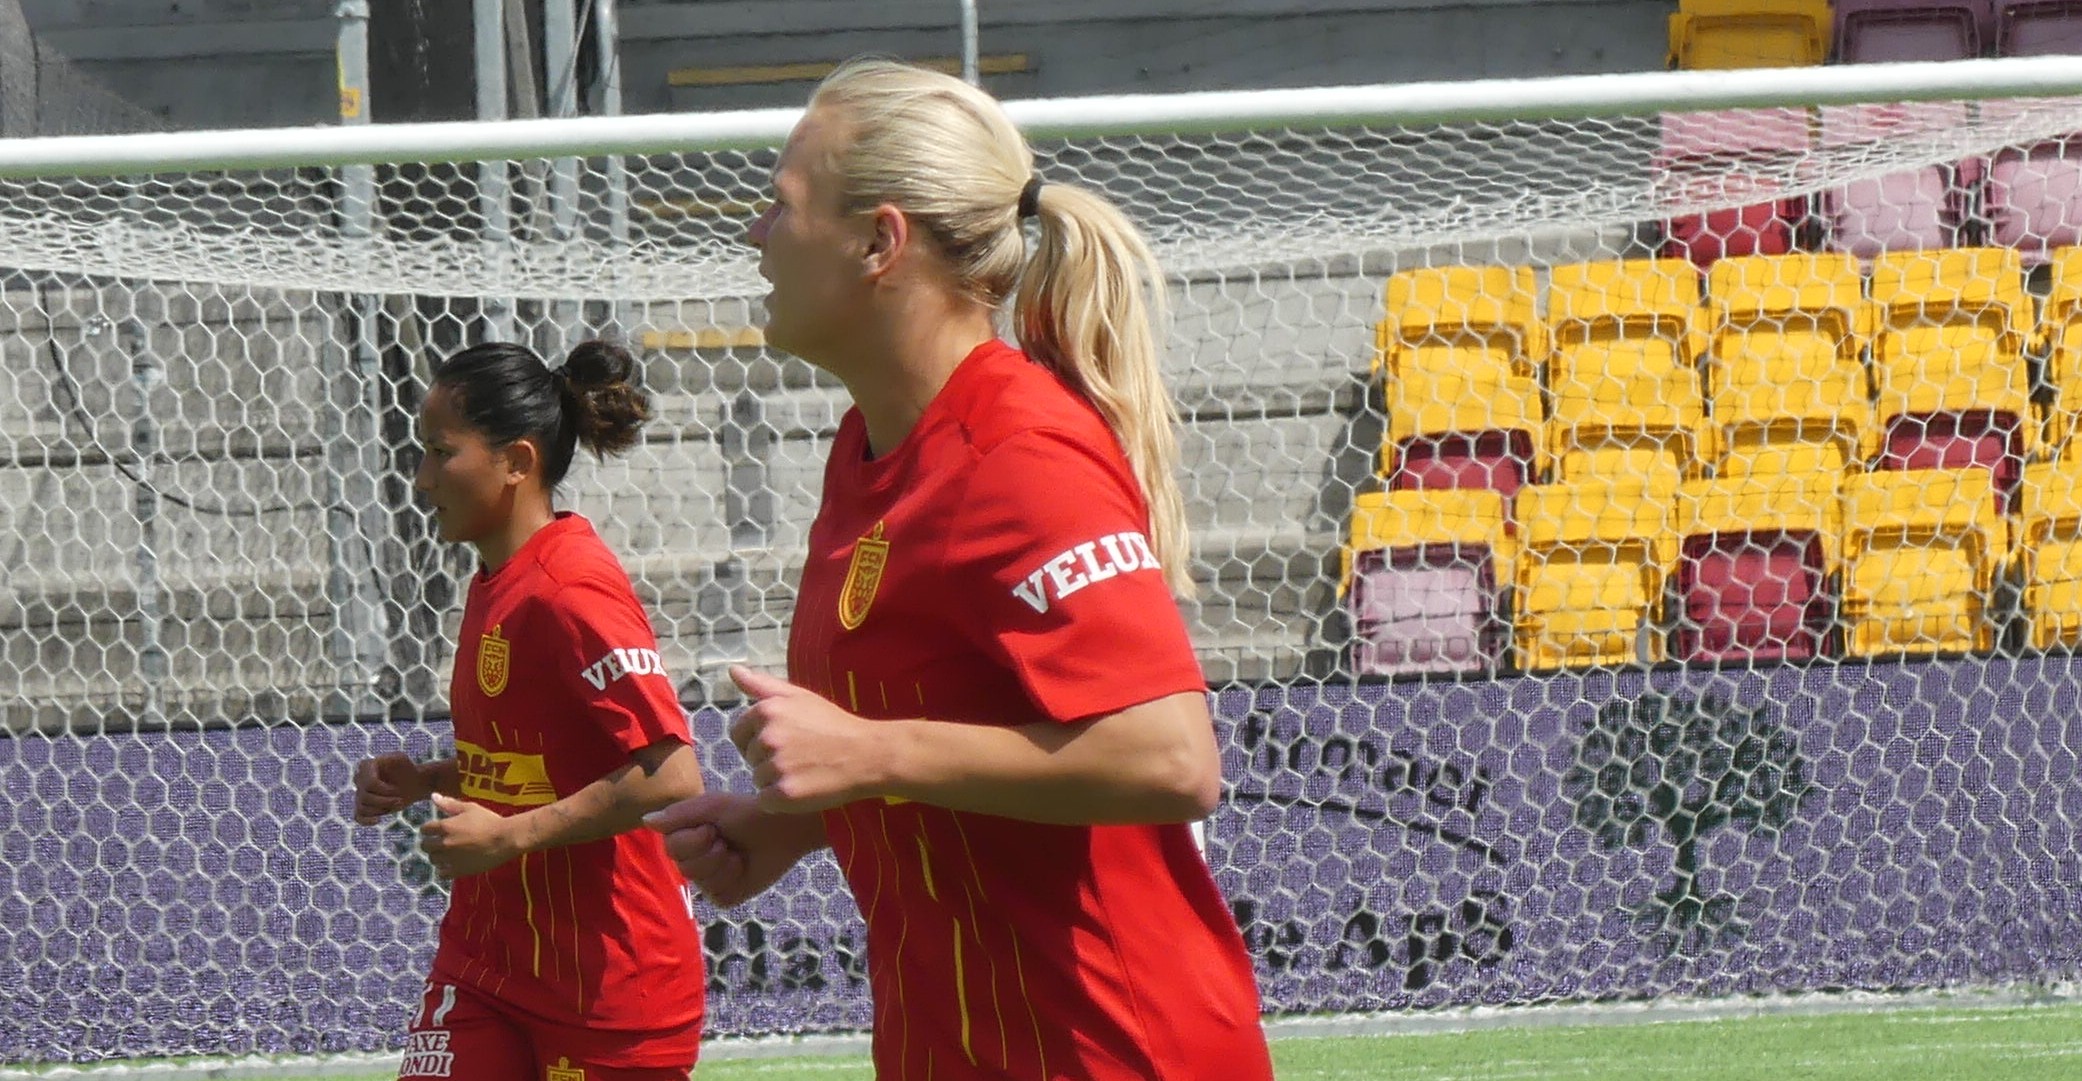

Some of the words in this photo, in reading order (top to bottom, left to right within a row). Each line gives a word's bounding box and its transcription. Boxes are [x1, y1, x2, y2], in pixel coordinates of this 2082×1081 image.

[1012, 531, 1161, 614] VELUX
[581, 648, 668, 691] VELUX
[405, 1032, 449, 1053] AXE
[400, 1054, 452, 1075] ONDI
